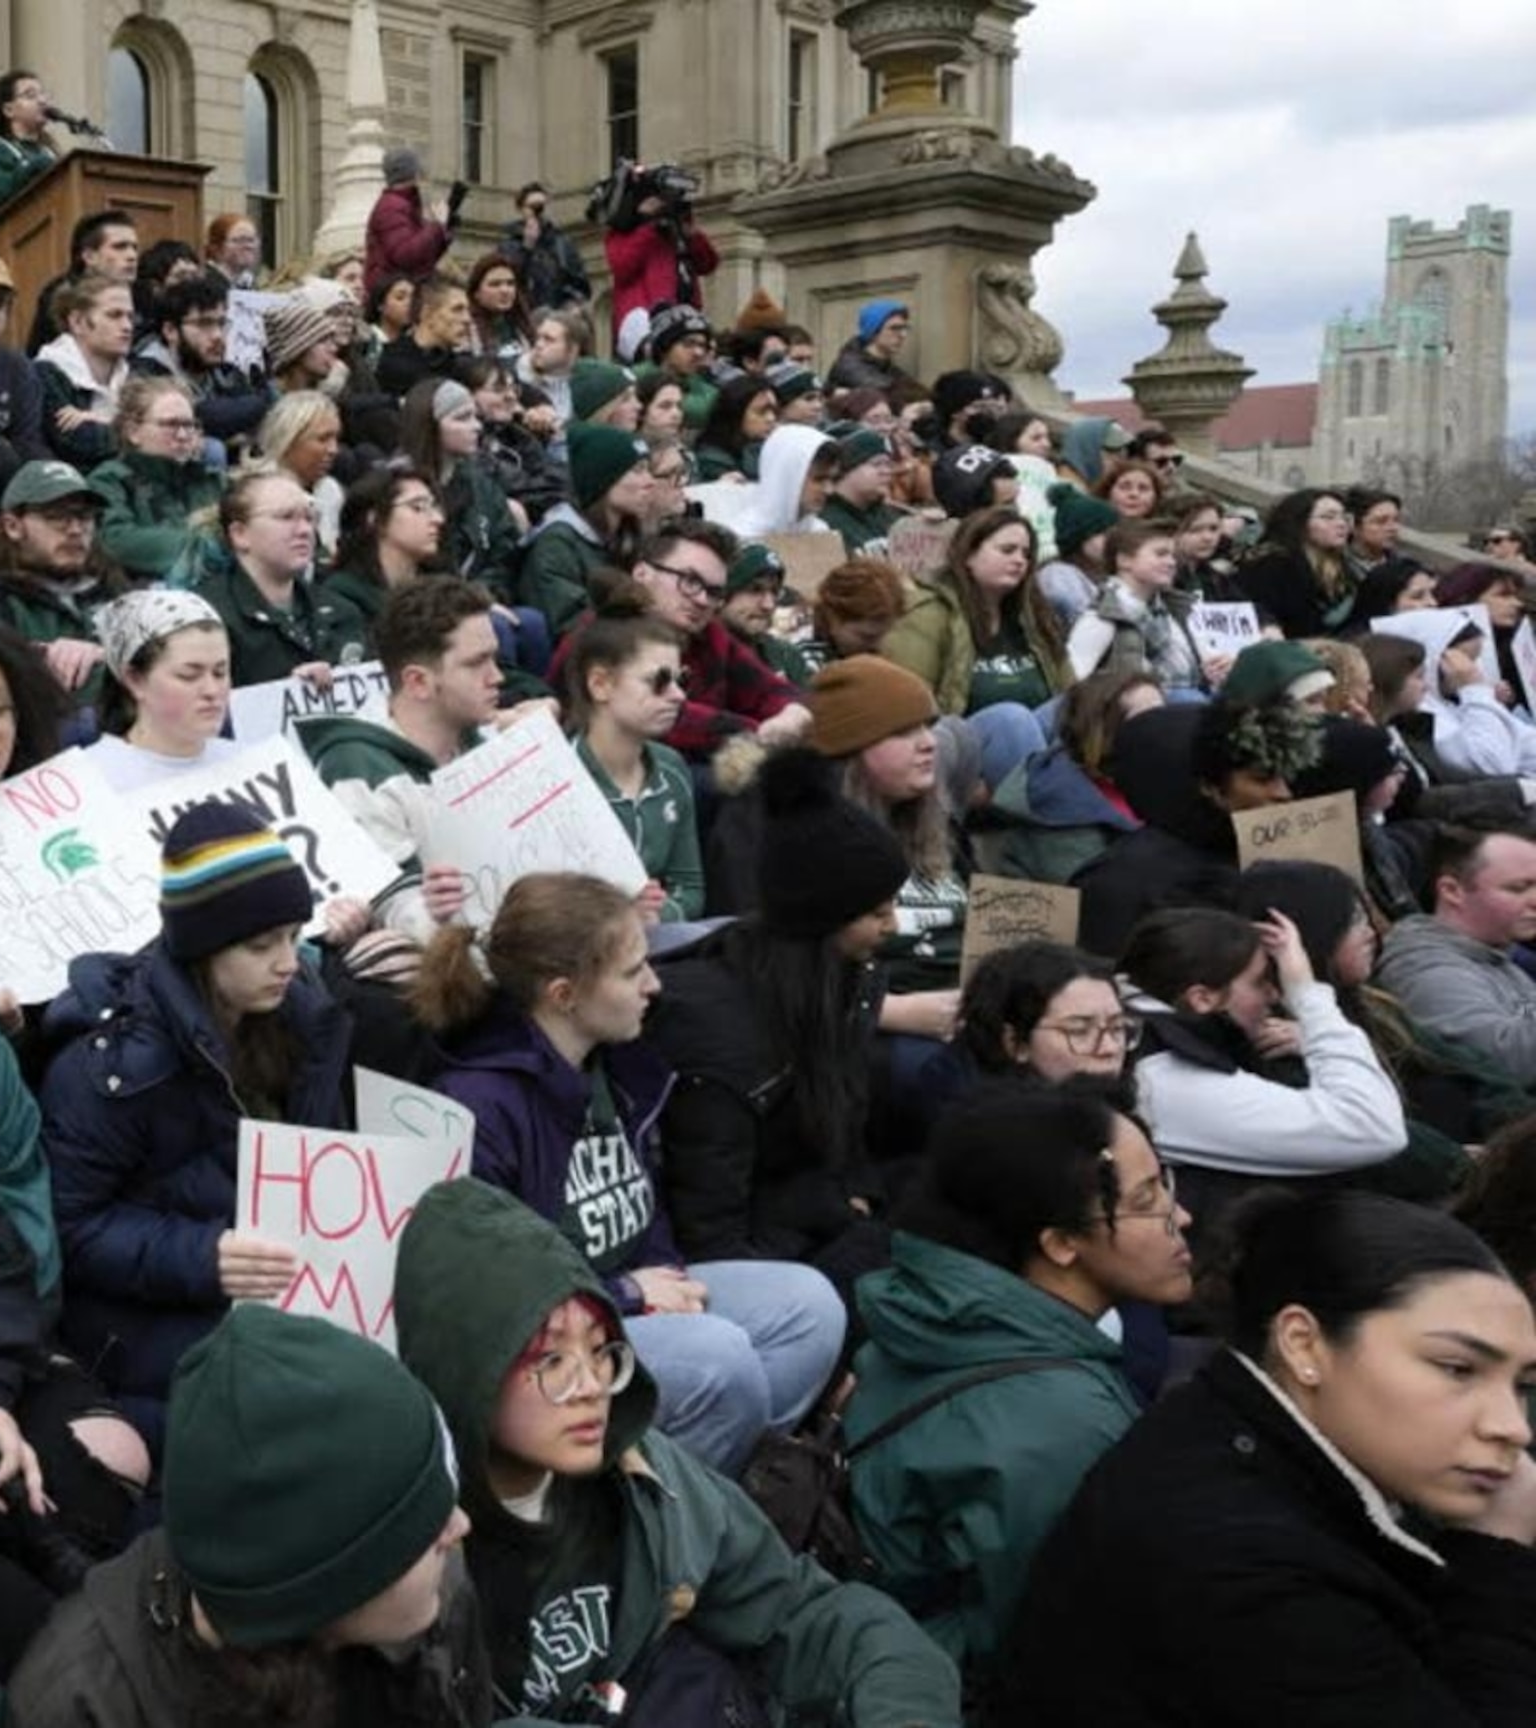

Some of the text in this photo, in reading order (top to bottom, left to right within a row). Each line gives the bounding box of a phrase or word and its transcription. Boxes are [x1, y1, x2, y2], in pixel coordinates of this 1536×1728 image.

[4, 767, 81, 832] NO
[278, 824, 340, 893] ?
[578, 1176, 655, 1257] STAT
